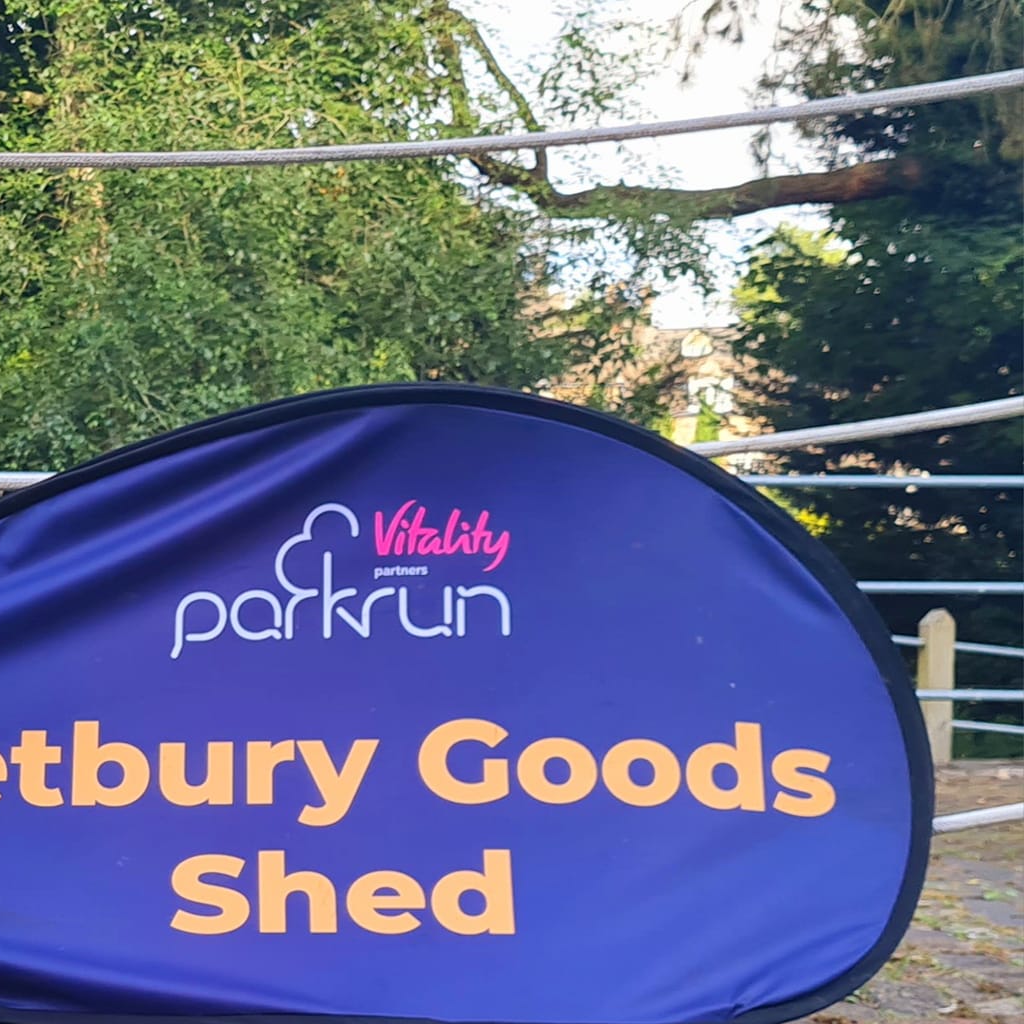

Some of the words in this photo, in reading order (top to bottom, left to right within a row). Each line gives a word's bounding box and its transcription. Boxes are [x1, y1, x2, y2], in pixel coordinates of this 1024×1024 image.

[373, 565, 428, 579] partners
[374, 499, 511, 572] Vitality
[170, 550, 511, 660] parkrun
[418, 718, 836, 818] Goods
[171, 849, 516, 936] Shed
